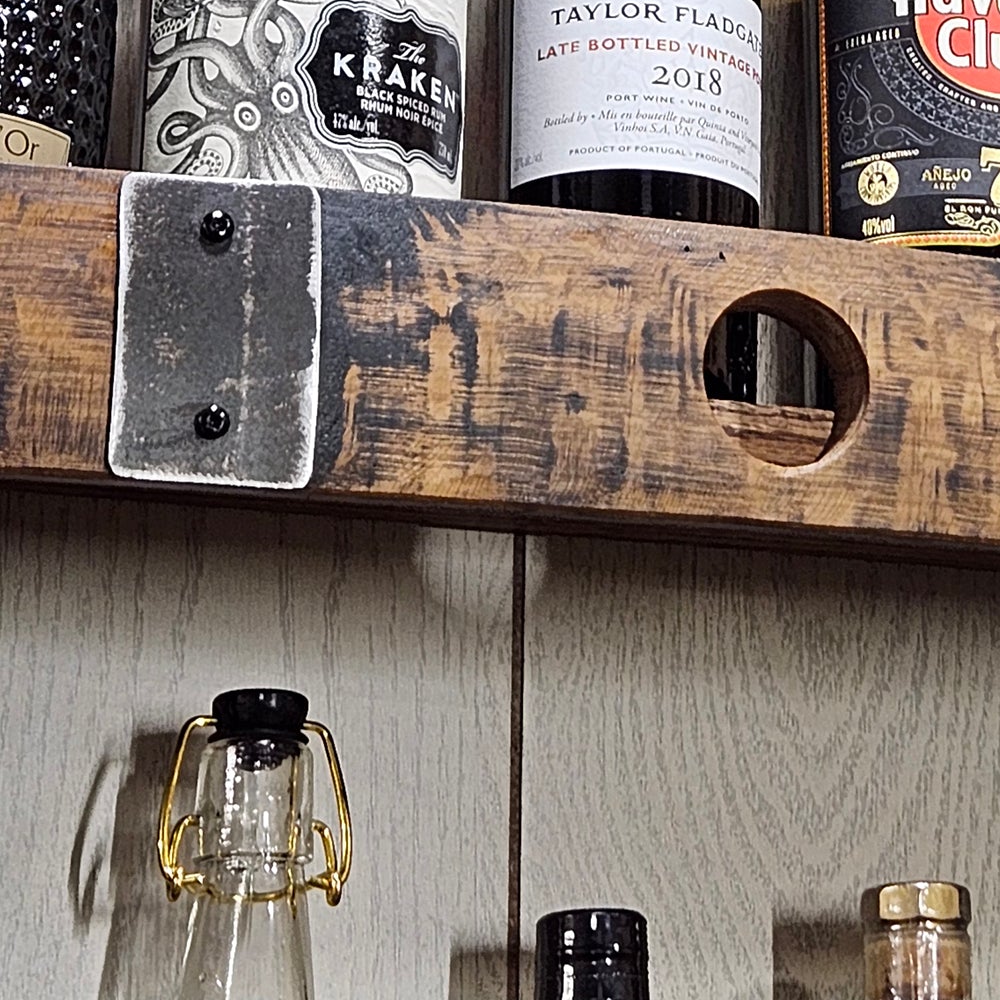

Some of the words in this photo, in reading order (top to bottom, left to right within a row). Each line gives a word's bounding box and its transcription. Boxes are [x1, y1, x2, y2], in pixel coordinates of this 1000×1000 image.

[551, 2, 667, 27] TAYLOR
[392, 41, 427, 66] The
[537, 40, 581, 63] LATE
[587, 37, 681, 53] BOTTLED
[686, 42, 751, 78] VINTAGE
[333, 51, 457, 115] KRAKEN
[651, 65, 723, 97] 2018
[356, 84, 394, 103] BLACK
[396, 93, 430, 114] SPICED
[360, 98, 393, 116] RHUM
[395, 105, 420, 124] NOIR
[606, 94, 639, 102] PORT
[642, 95, 676, 105] WINE
[687, 99, 707, 110] VIN
[543, 112, 576, 129] Bottled
[576, 111, 589, 125] by
[597, 108, 618, 121] Mis
[620, 112, 633, 120] en
[635, 108, 678, 122] bouteille
[679, 116, 697, 127] par
[568, 145, 617, 156] PRODUCT
[618, 145, 632, 153] OF
[634, 145, 687, 157] PORTUGAL
[695, 152, 729, 167] PRODUIT
[921, 165, 972, 183] AÑEJO
